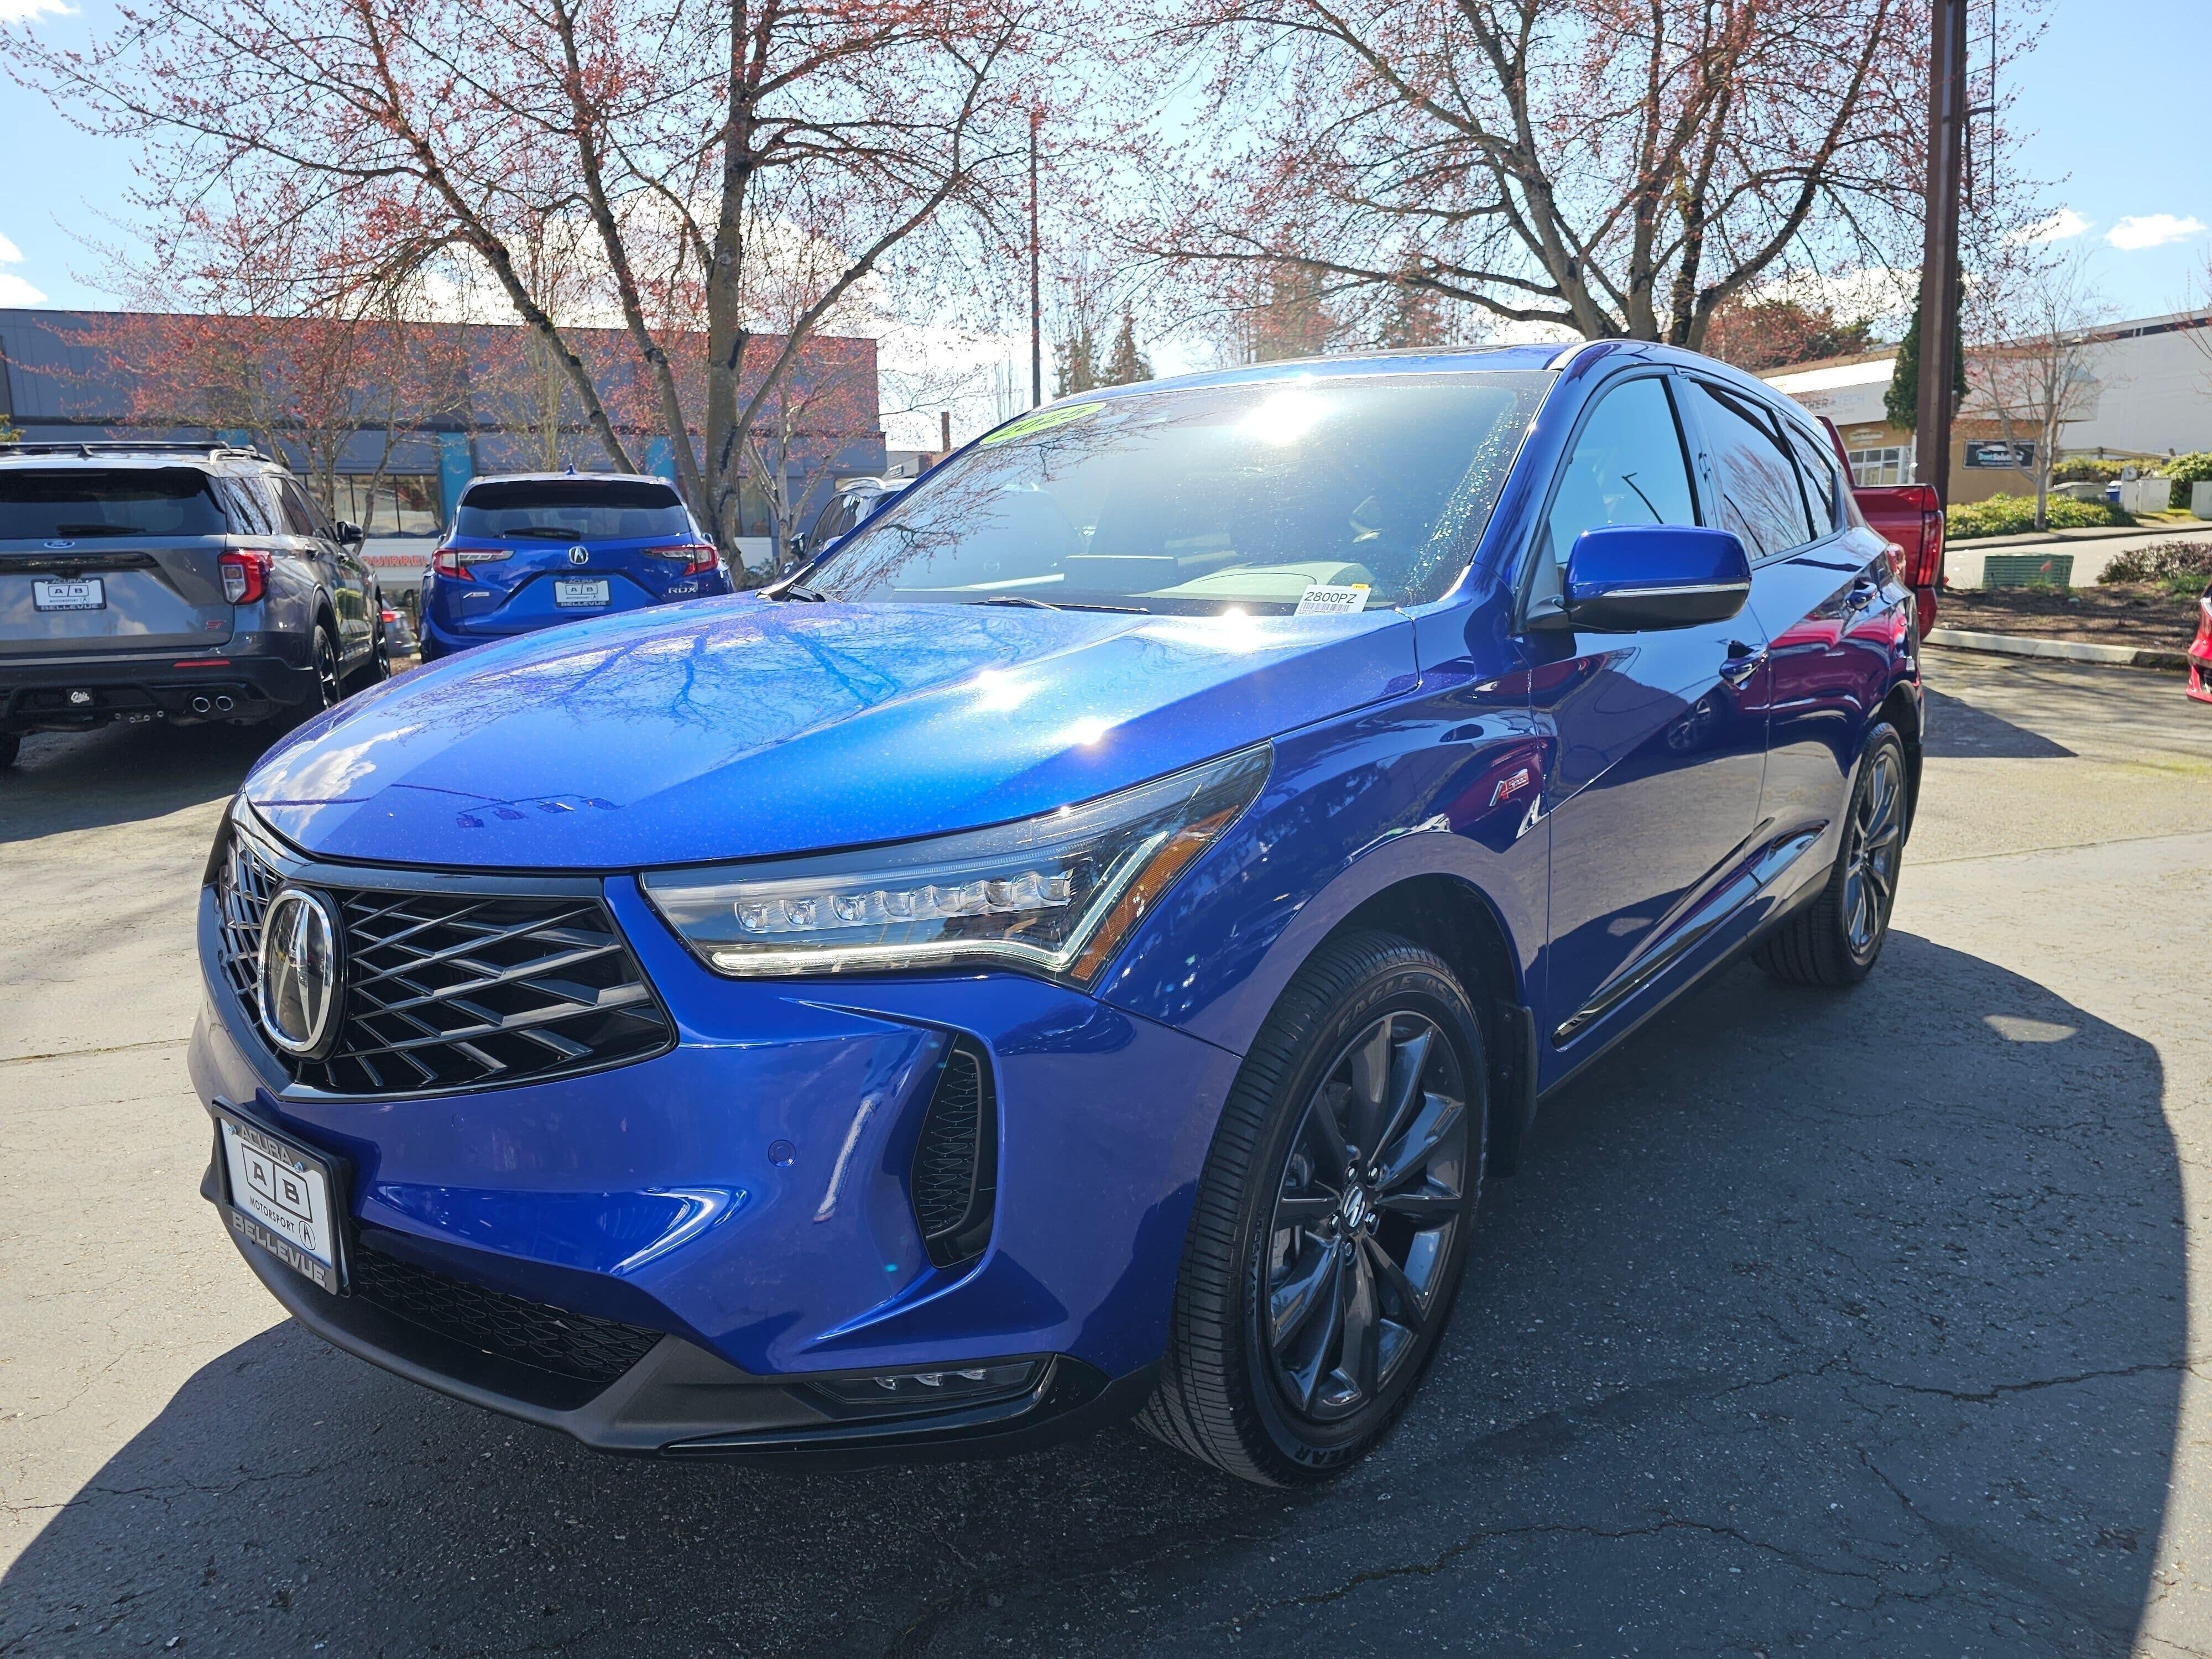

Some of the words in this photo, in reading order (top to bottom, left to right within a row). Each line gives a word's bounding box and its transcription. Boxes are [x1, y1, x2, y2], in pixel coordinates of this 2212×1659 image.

[1304, 592, 1358, 604] 2800PZ
[205, 619, 227, 630] ST
[241, 1124, 295, 1167] ACURA
[252, 1161, 268, 1187] A
[281, 1178, 300, 1206] B
[250, 1195, 295, 1234] MOTORSPORT
[231, 1211, 327, 1288] BELLEVUE
